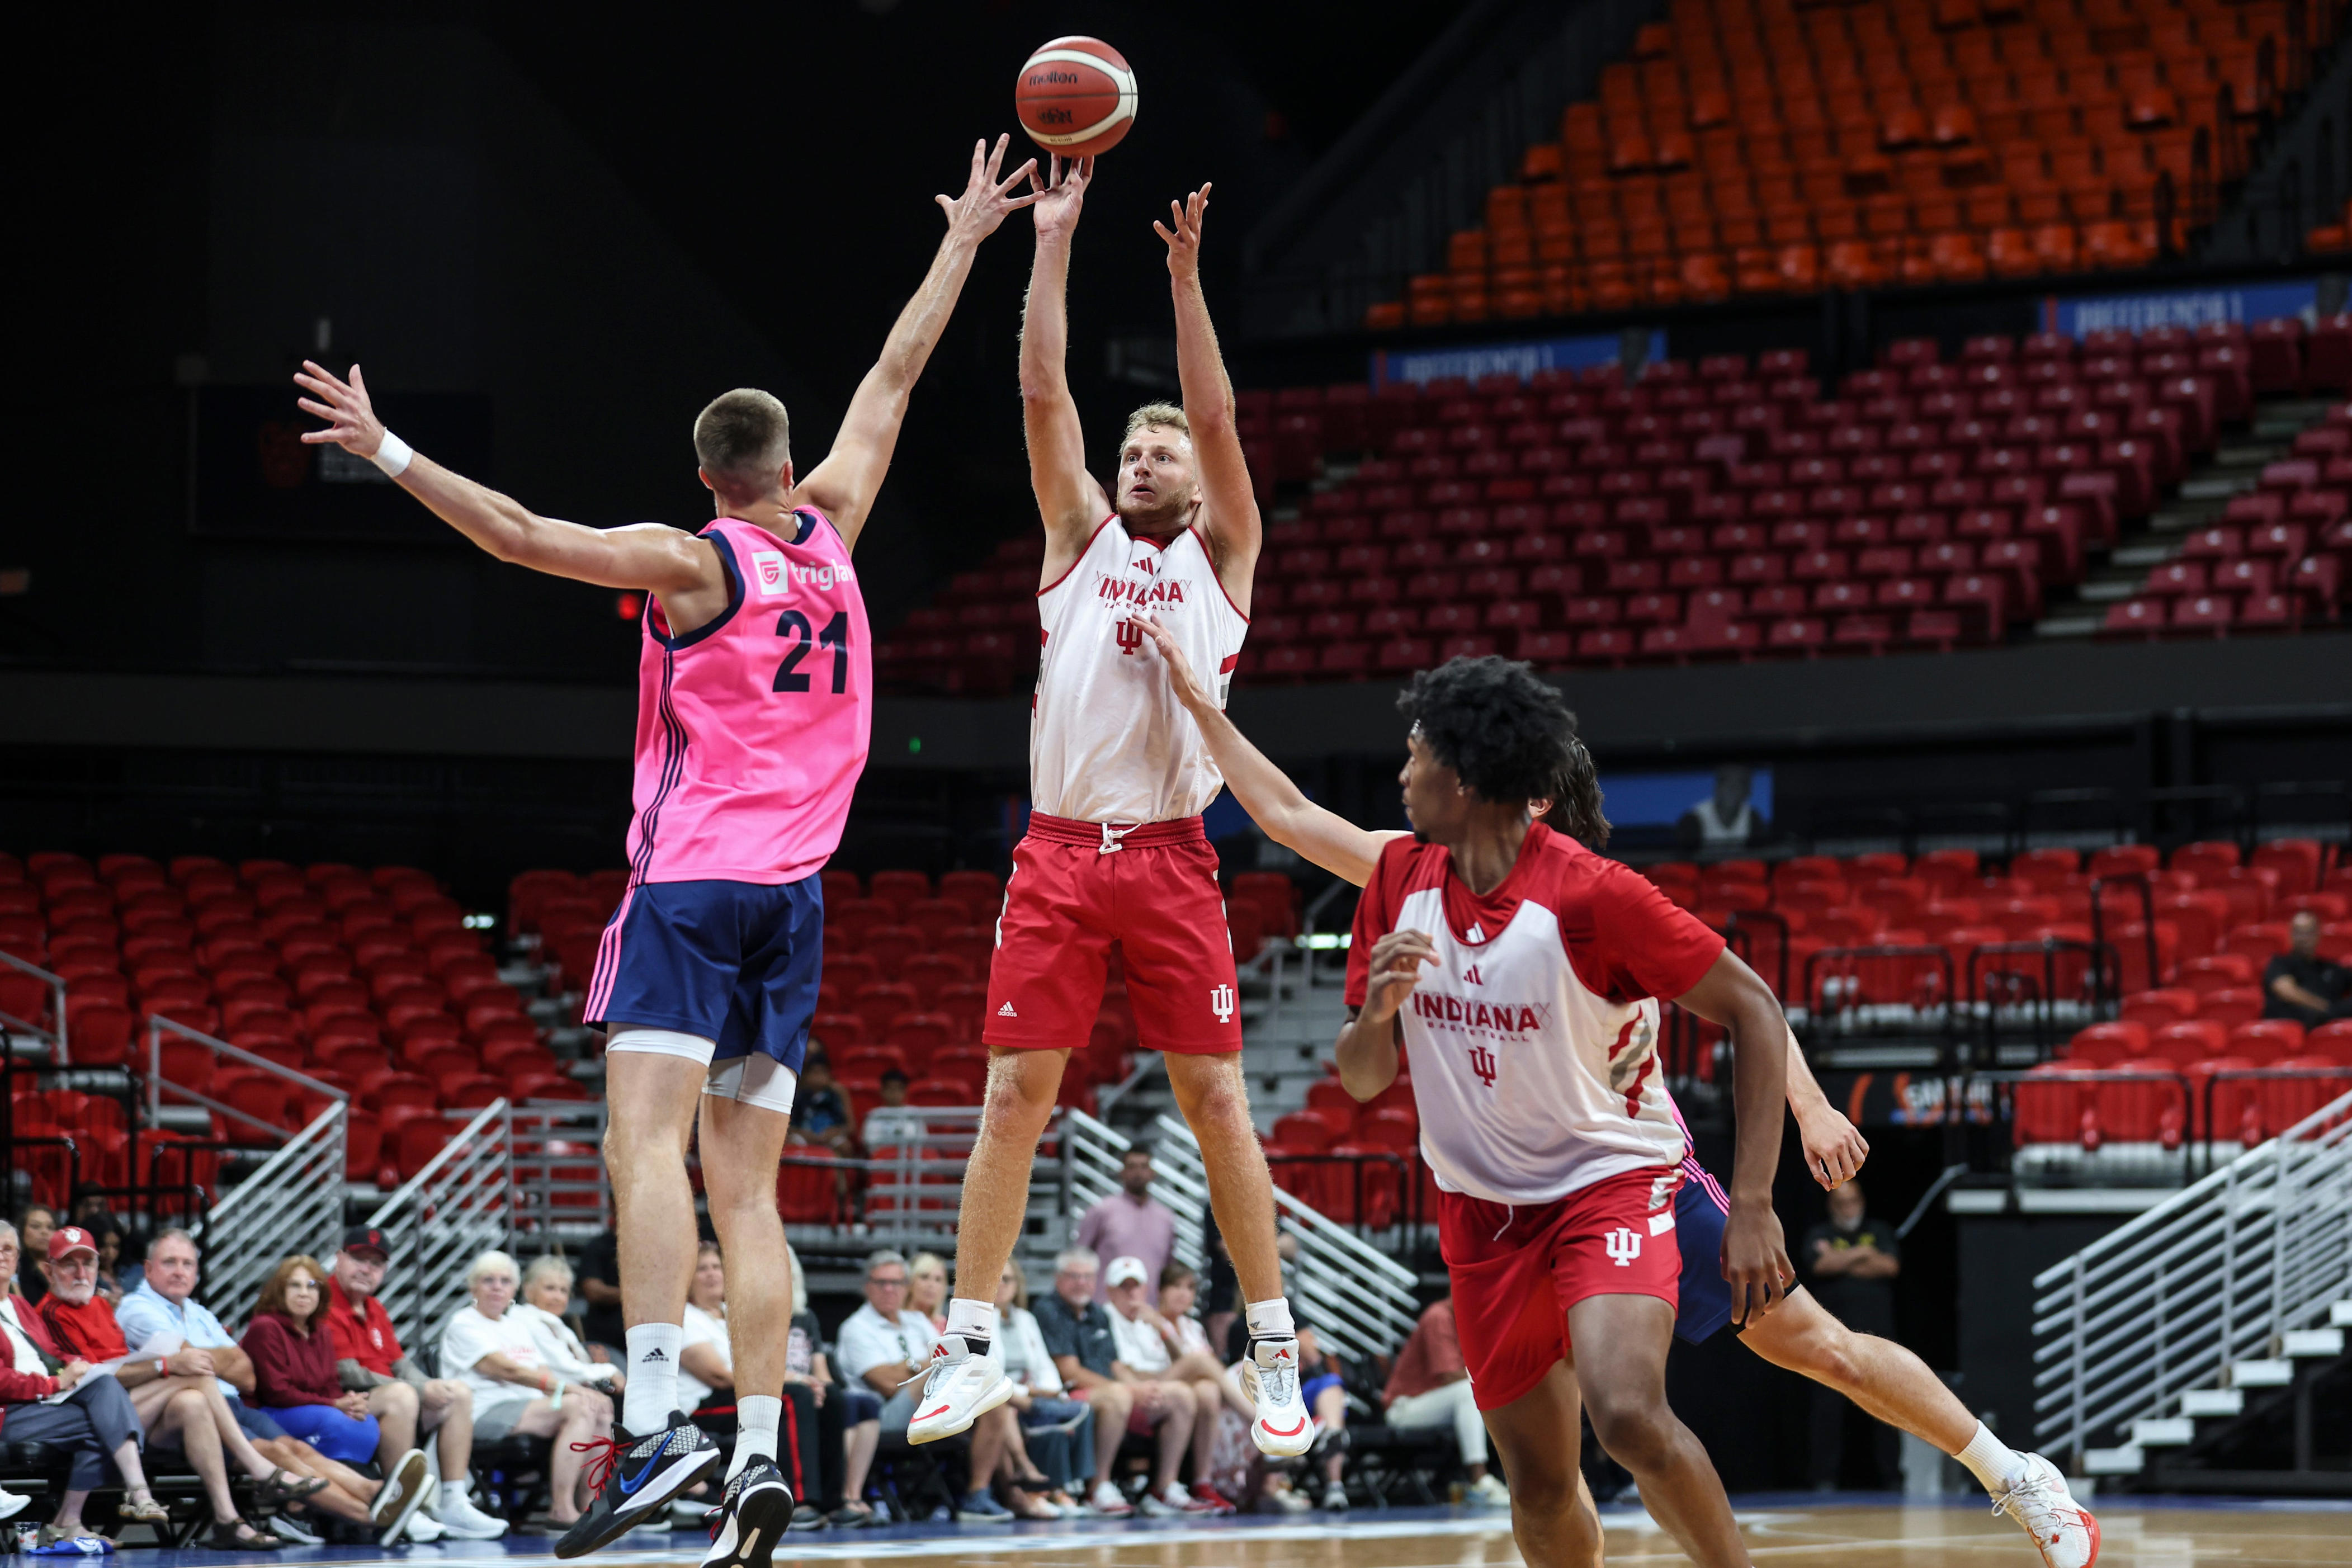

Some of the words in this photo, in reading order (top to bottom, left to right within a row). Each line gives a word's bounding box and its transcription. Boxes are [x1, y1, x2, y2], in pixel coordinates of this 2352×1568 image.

[1099, 577, 1184, 607] INDIANA
[772, 610, 848, 694] 21
[1414, 992, 1541, 1032] INDIANA
